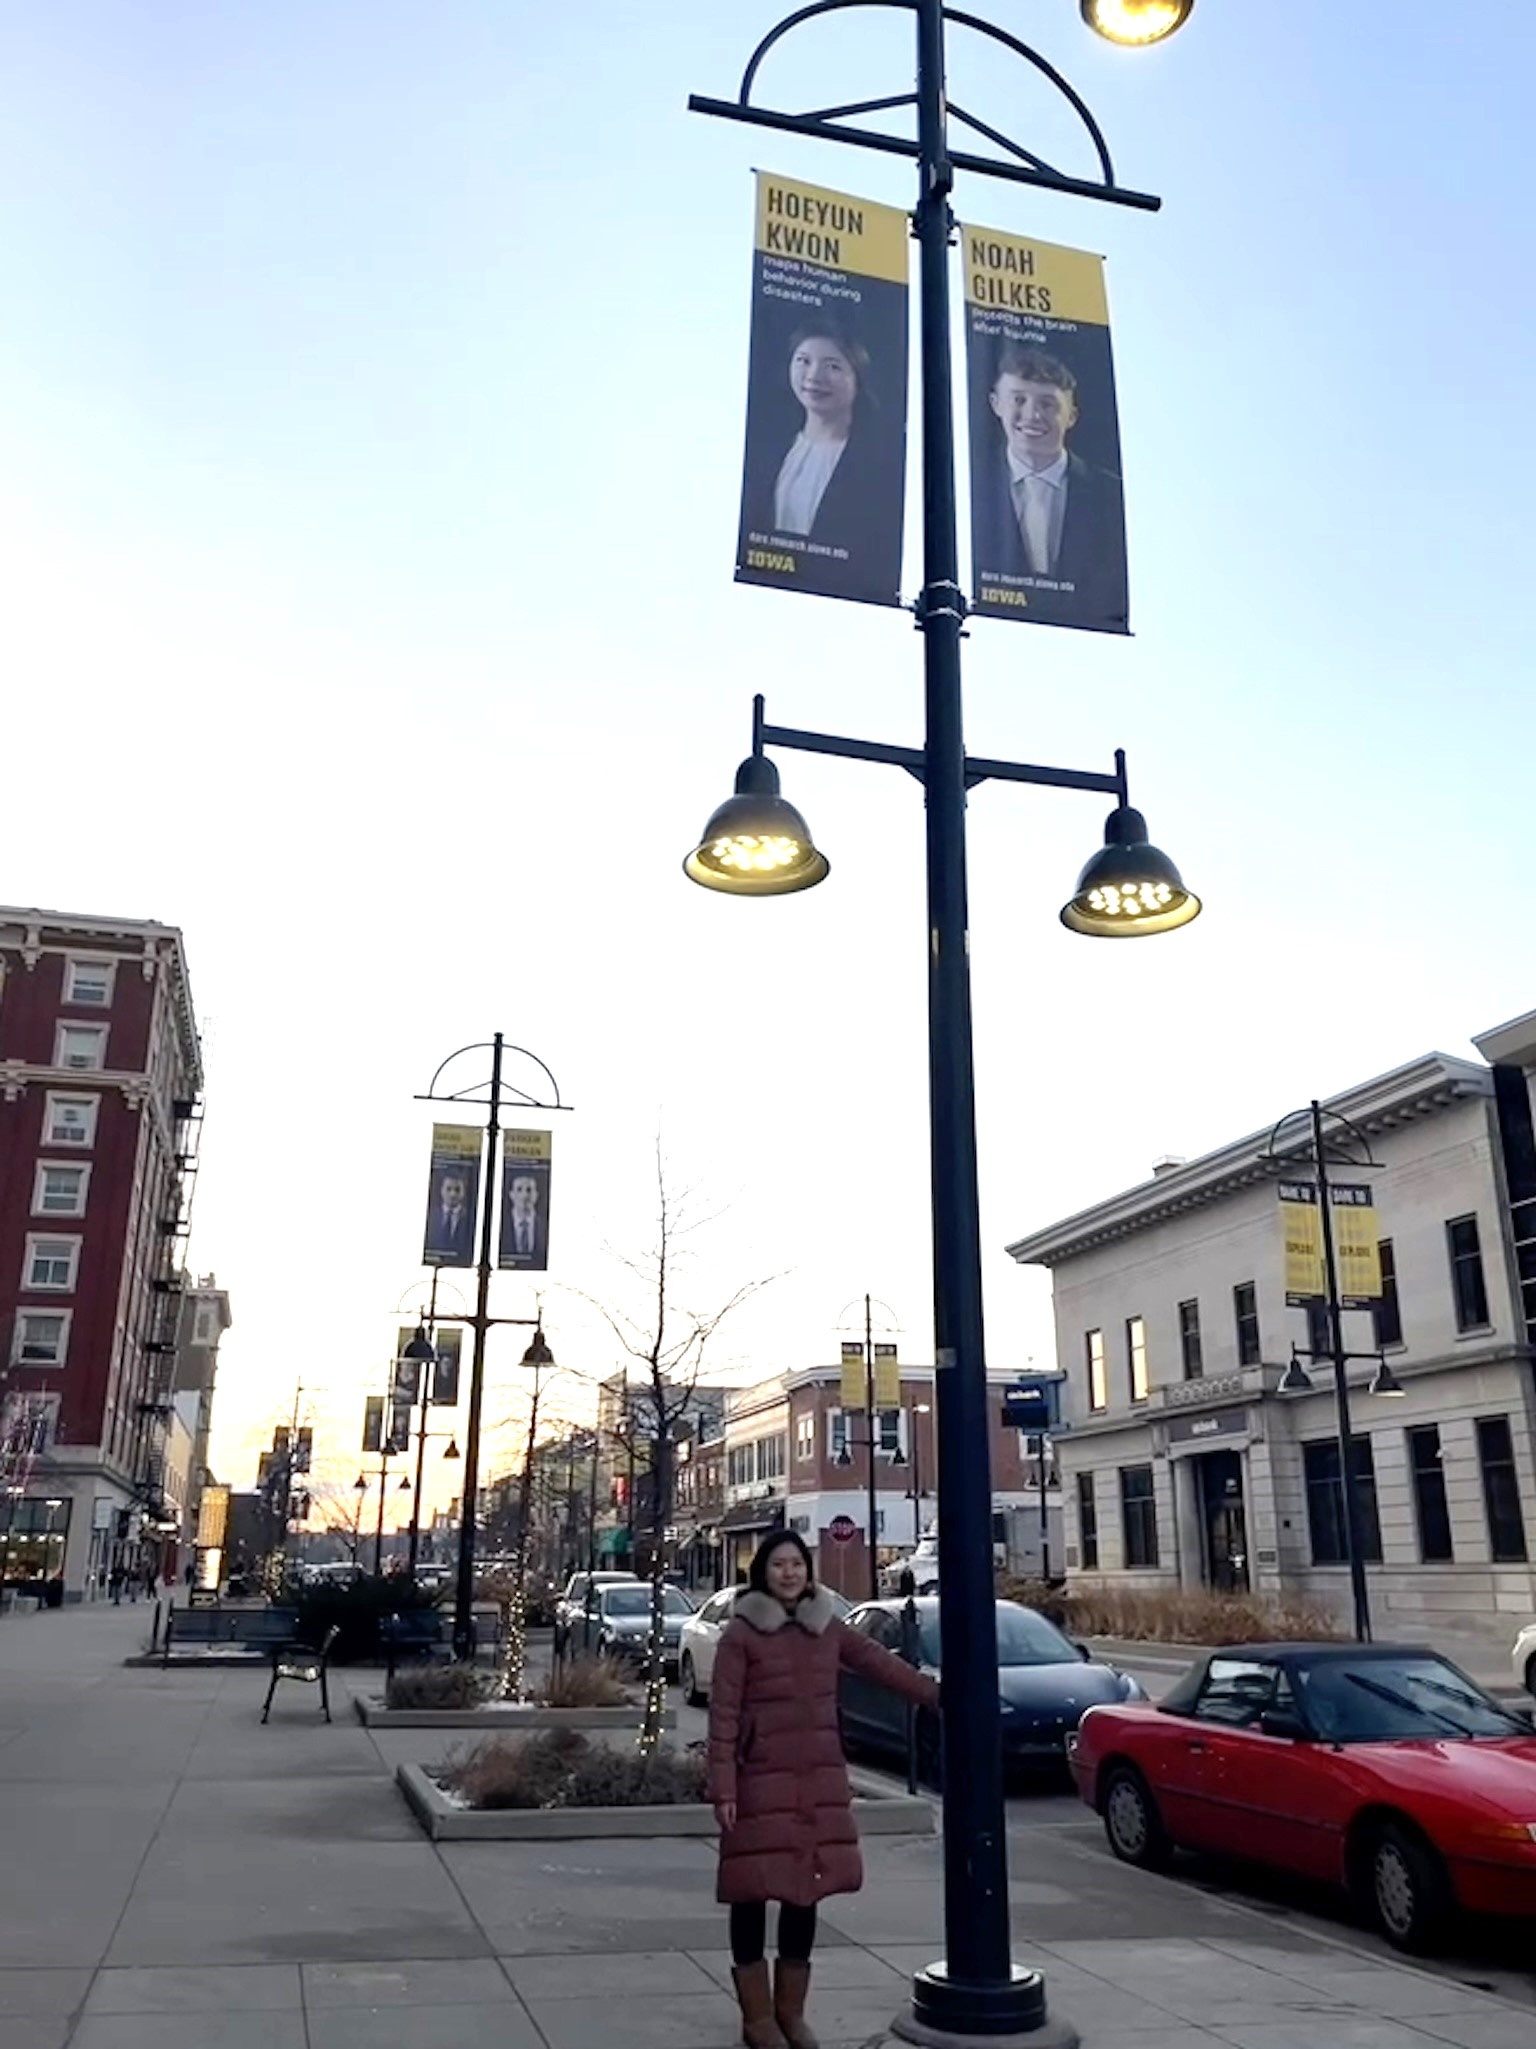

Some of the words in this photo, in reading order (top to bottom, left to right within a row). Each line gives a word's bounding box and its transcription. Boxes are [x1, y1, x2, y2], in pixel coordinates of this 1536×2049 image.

[768, 187, 863, 236] HOEYUN
[766, 221, 839, 264] KWON
[971, 239, 1034, 276] NOAH
[762, 255, 800, 273] maps
[802, 262, 847, 283] human
[762, 270, 818, 291] behavior
[819, 281, 862, 303] during
[762, 284, 823, 307] disasters
[972, 274, 1051, 313] GILKES
[747, 549, 796, 573] IOWA
[981, 586, 1028, 607] IOWA
